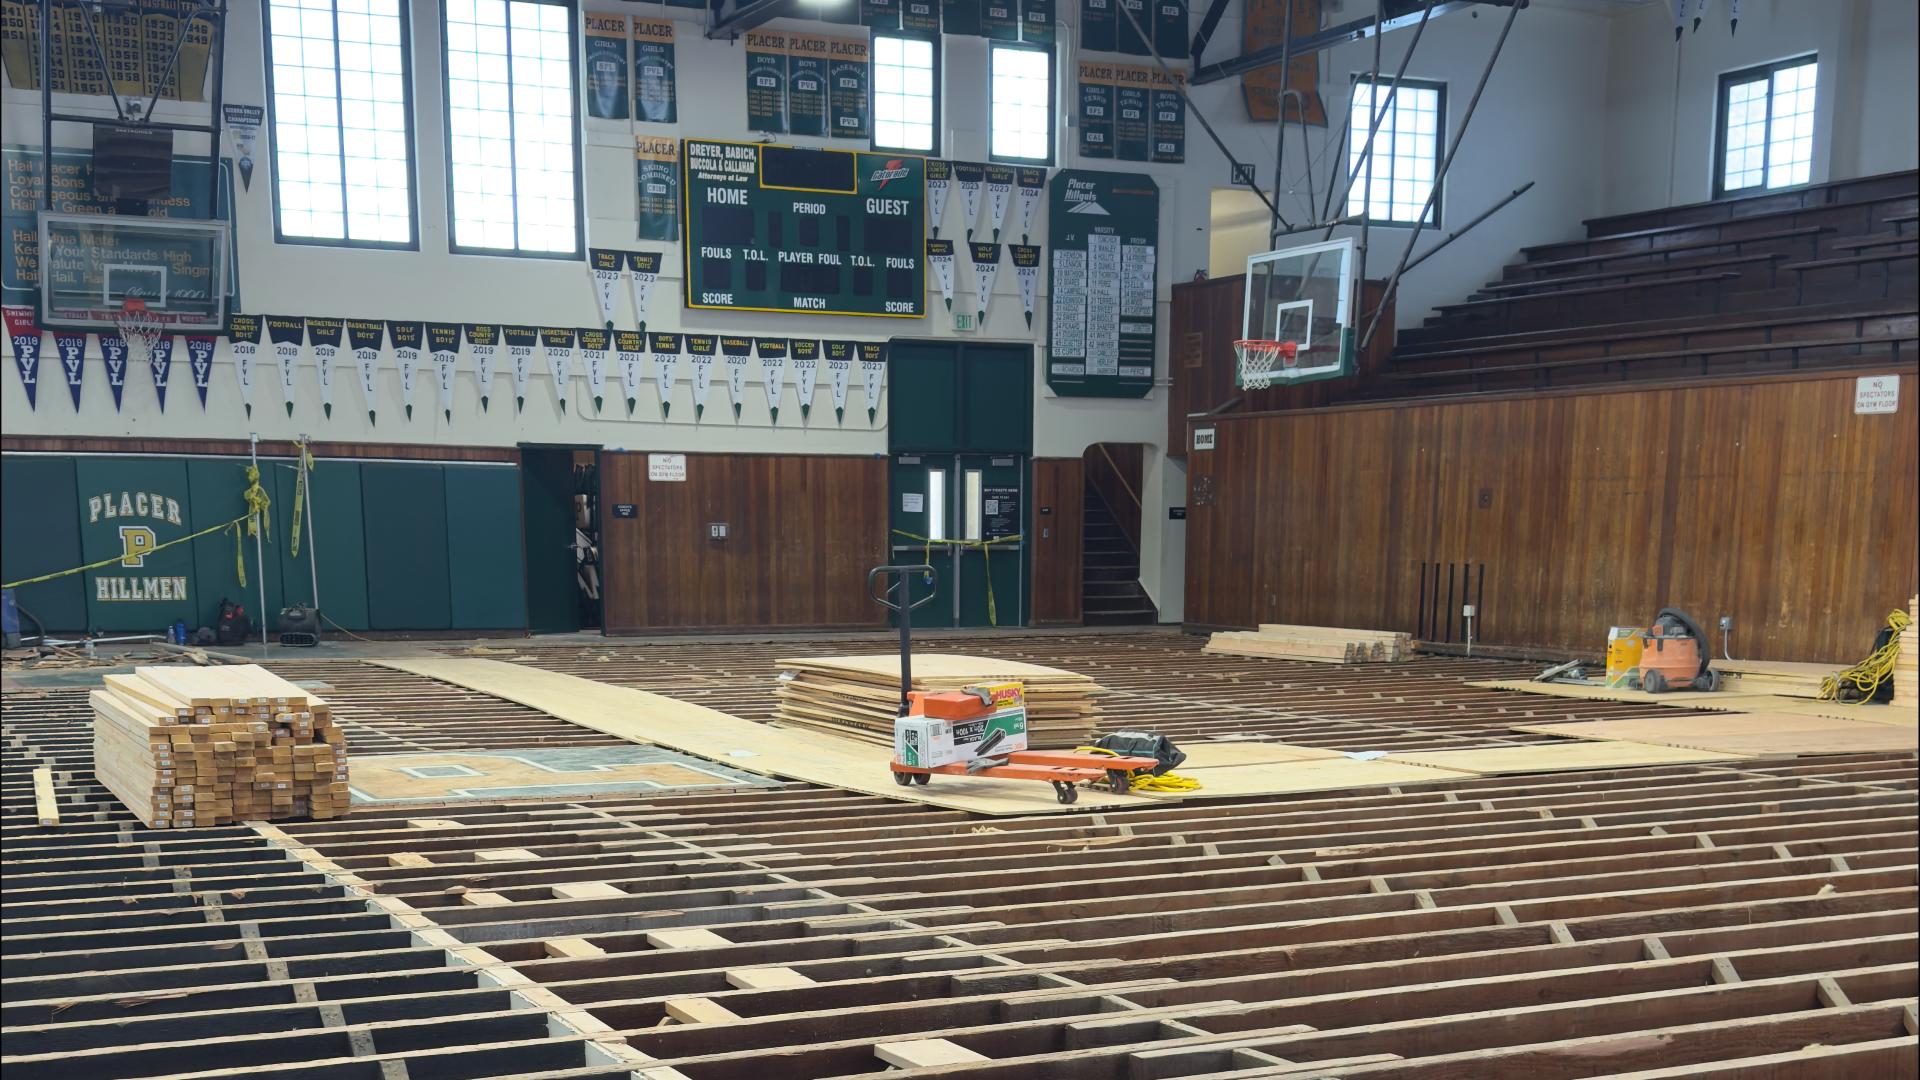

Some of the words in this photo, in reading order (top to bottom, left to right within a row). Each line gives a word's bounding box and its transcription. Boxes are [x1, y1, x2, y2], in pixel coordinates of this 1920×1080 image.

[586, 17, 625, 33] PLACER
[634, 22, 672, 37] PLACER
[594, 40, 617, 48] GIRLS
[747, 33, 785, 49] PLACER
[789, 38, 826, 52] PLACER
[642, 44, 664, 53] GIRLS
[830, 41, 867, 56] PLACER
[831, 64, 865, 78] BASEBALL
[1079, 66, 1112, 80] PLACER
[1116, 70, 1148, 83] PLACER
[800, 81, 816, 89] PVL
[842, 118, 857, 126] PVL
[636, 141, 675, 156] PLACER
[690, 143, 724, 160] DREYER,
[725, 146, 757, 163] BABICH,
[8, 159, 32, 171] Hail
[690, 157, 717, 170] BUCCOLA
[718, 159, 723, 171] &
[697, 172, 727, 181] Attorneys
[870, 168, 910, 181] Gatorade
[51, 175, 85, 188] Sons
[1067, 178, 1096, 190] Placer
[707, 187, 748, 205] HOME
[1064, 189, 1097, 202] Hillgals
[11, 198, 35, 211] Hail
[62, 201, 102, 214] Green
[793, 202, 826, 214] PERIOD
[866, 198, 910, 216] GUEST
[1094, 226, 1115, 234] VARSITY
[80, 232, 119, 246] Mater
[92, 247, 159, 261] Standards
[163, 250, 192, 265] High
[701, 247, 732, 259] FOULS
[742, 249, 769, 261] T.O.L.
[778, 251, 813, 264] PLAYER
[818, 253, 842, 265] FOUL
[850, 255, 875, 267] T.O.L.
[886, 257, 915, 269] FOULS
[702, 292, 733, 304] SCORE
[793, 297, 826, 309] MATCH
[885, 301, 914, 313] SCORE
[268, 321, 303, 329] FOOTBALL
[347, 322, 382, 330] BASKETBALL
[956, 314, 972, 329] EXIT
[504, 328, 535, 336] FOOTBALL
[14, 336, 38, 346] 2018
[58, 338, 83, 347] 2018
[102, 338, 126, 347] 2018
[190, 341, 212, 350] 2018
[234, 345, 255, 354] 2018
[277, 346, 298, 356] 2018
[315, 347, 335, 356] 2019
[356, 351, 377, 360] 2019
[396, 350, 417, 360] 2019
[473, 346, 494, 355] 2019
[511, 346, 531, 356] 2019
[548, 348, 570, 357] 2020
[584, 350, 605, 359] 2021
[434, 353, 455, 363] 2019
[619, 353, 639, 361] 2021
[655, 355, 677, 363] 2022
[691, 356, 712, 364] 2022
[727, 356, 747, 365] 2020
[762, 359, 783, 367] 2022
[20, 345, 35, 384] PVL
[66, 347, 81, 385] PVL
[108, 347, 122, 385] PVL
[153, 350, 167, 387] PVL
[194, 350, 208, 387] PVL
[794, 361, 816, 369] 2022
[1872, 381, 1883, 389] NO
[1859, 390, 1895, 398] SPECTATORS
[1196, 434, 1213, 445] HOME
[88, 491, 182, 526] PLACER
[118, 525, 157, 568] P
[95, 576, 188, 601] HILLMEN
[996, 687, 1020, 699] HUSKY
